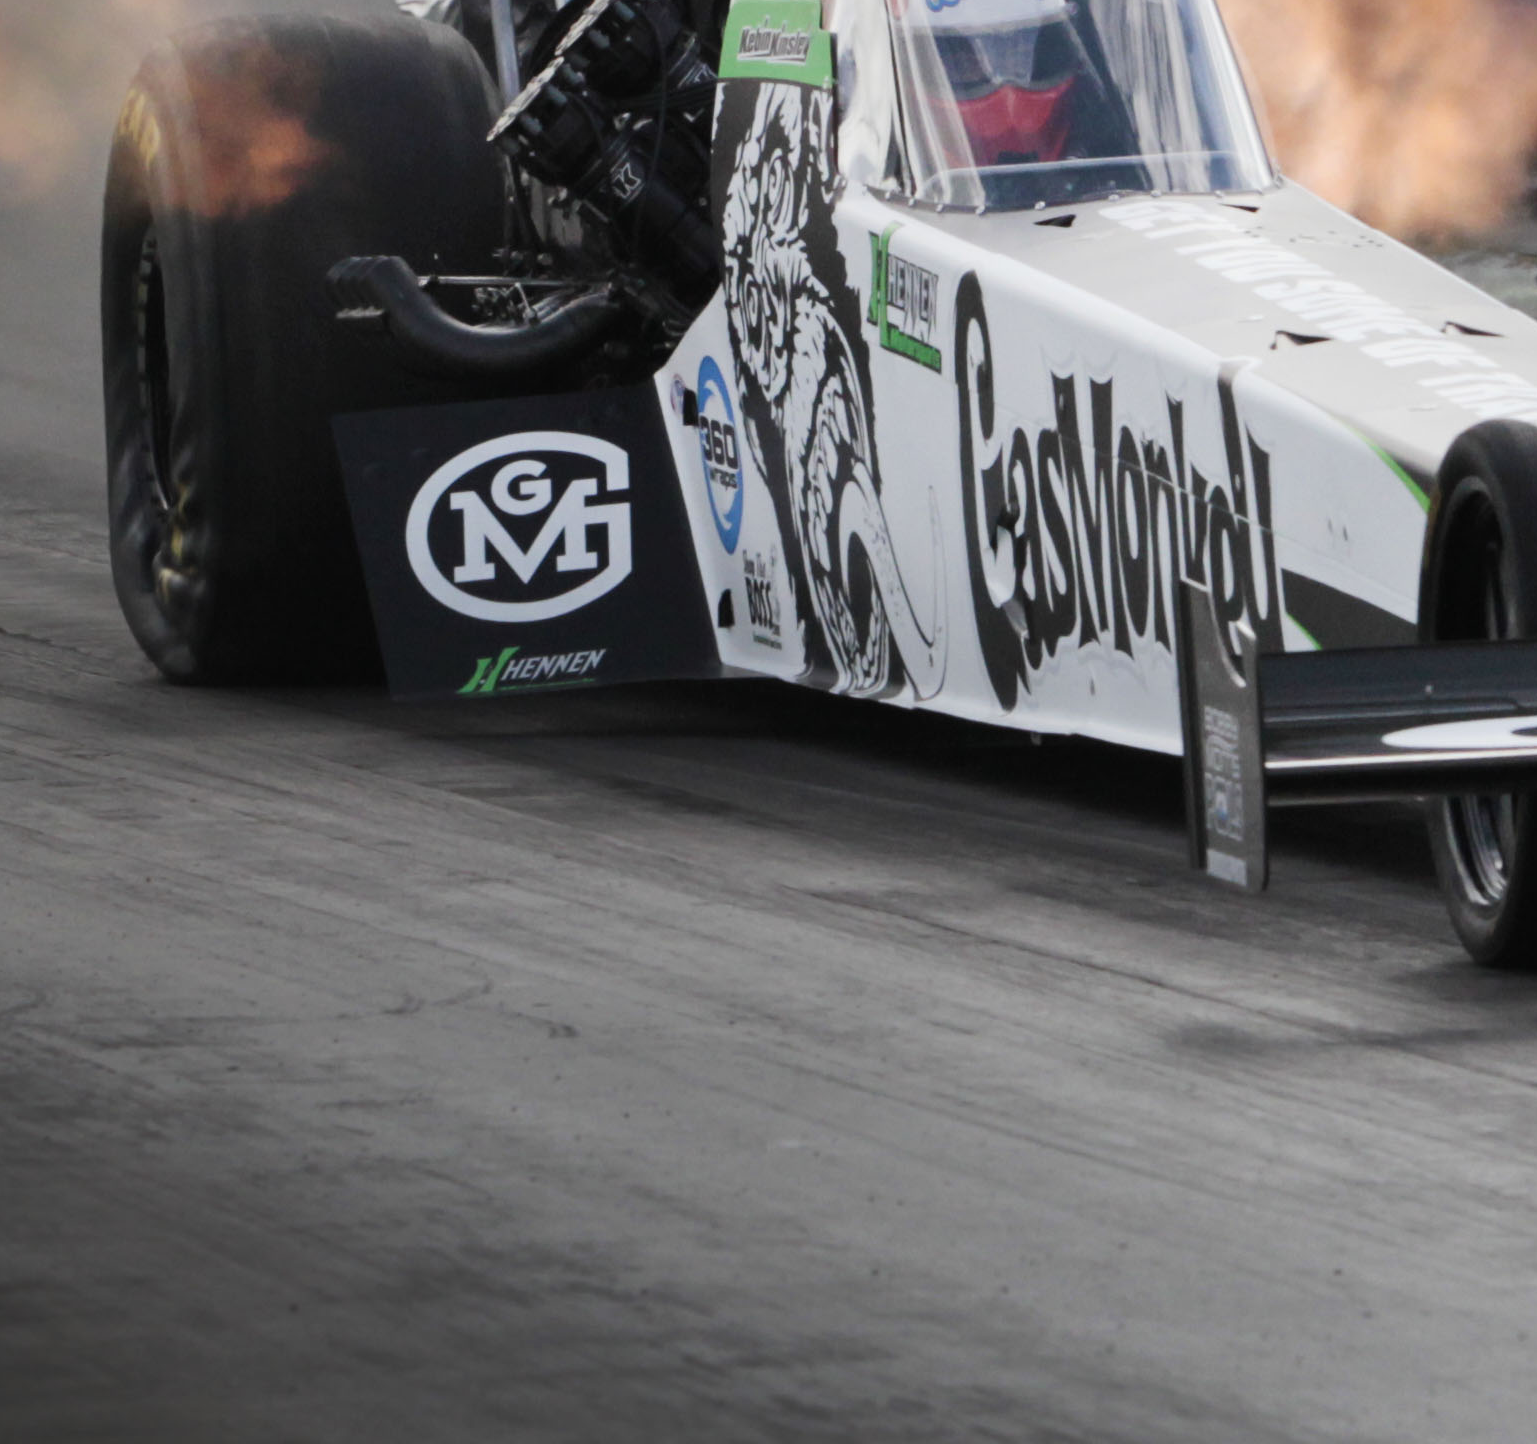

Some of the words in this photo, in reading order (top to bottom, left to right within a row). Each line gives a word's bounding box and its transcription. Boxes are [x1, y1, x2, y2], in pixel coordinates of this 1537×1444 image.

[699, 415, 738, 470] 360
[710, 466, 738, 491] wraps
[501, 648, 607, 683] HENNEN
